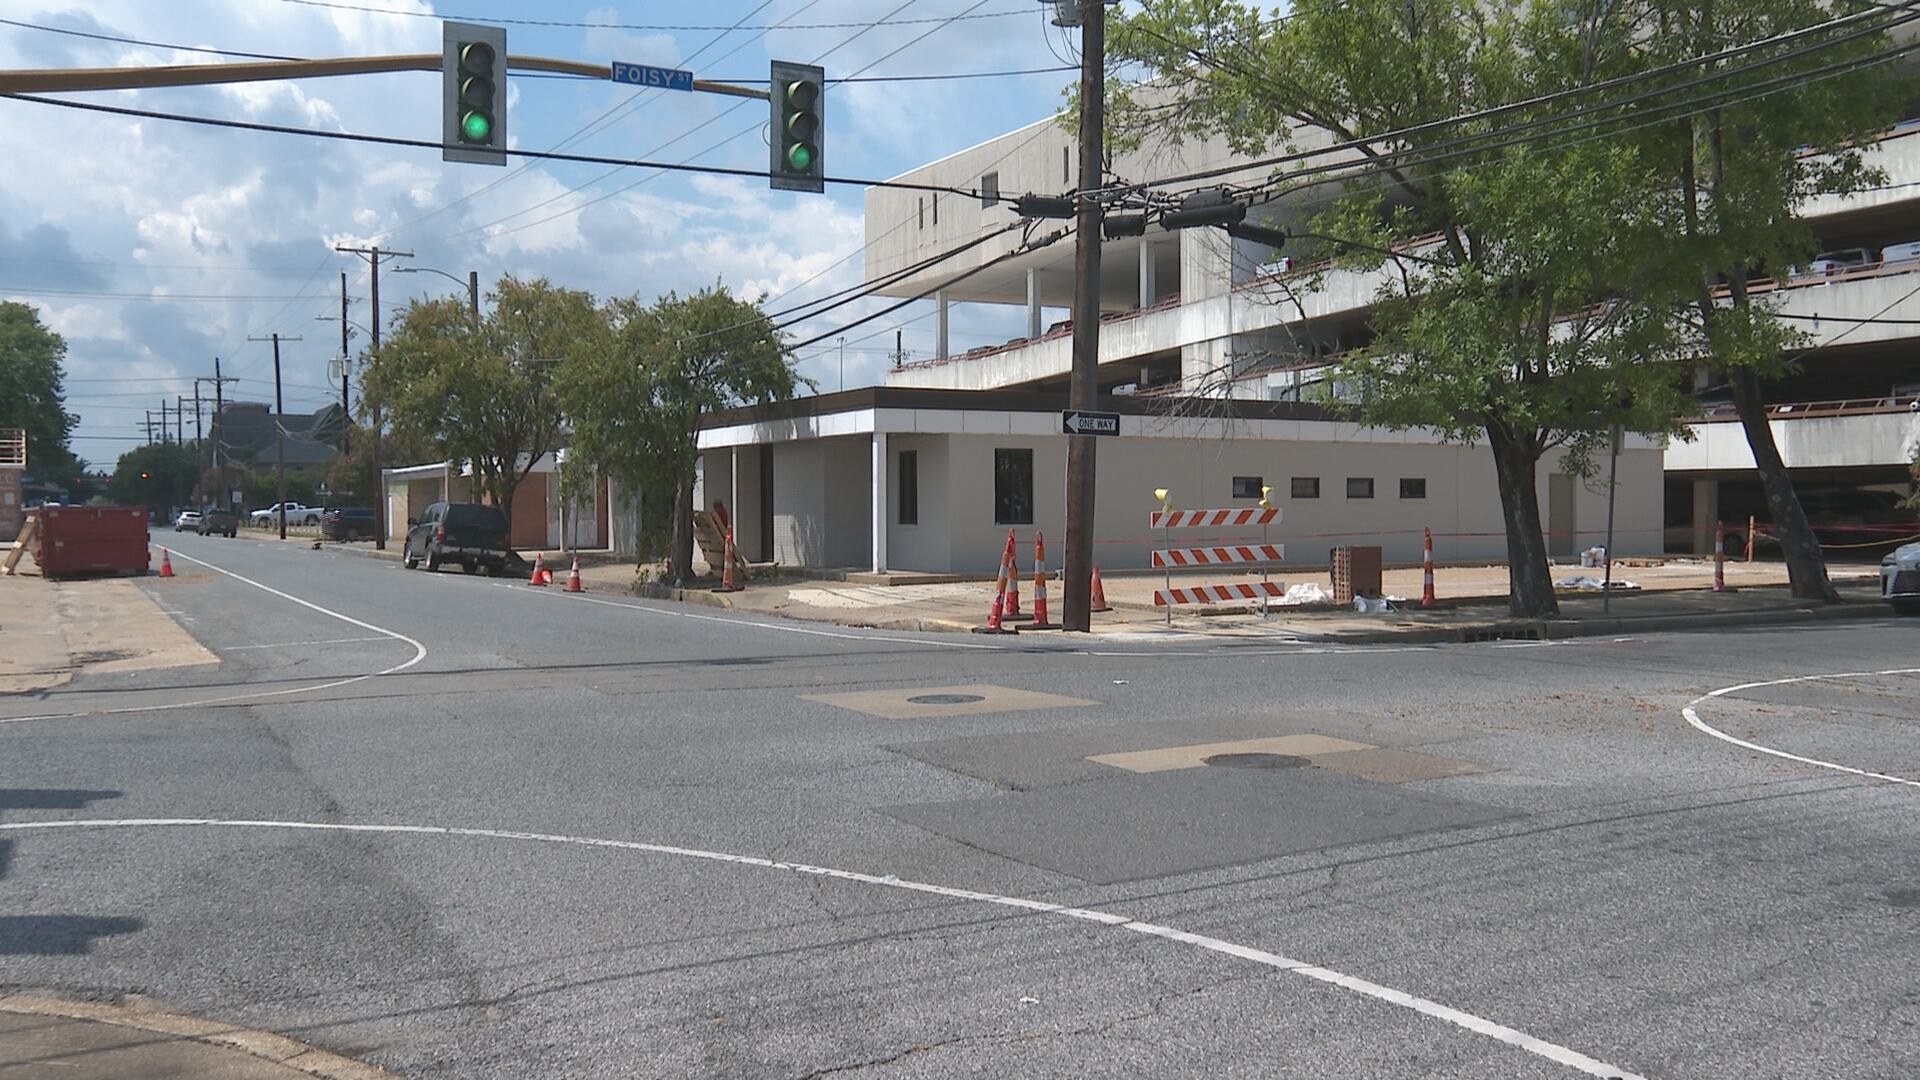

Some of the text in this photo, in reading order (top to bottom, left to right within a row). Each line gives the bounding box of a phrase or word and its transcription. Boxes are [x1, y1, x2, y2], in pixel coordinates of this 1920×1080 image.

[615, 65, 691, 87] FOISY ST
[1079, 418, 1114, 429] ONE WAY
